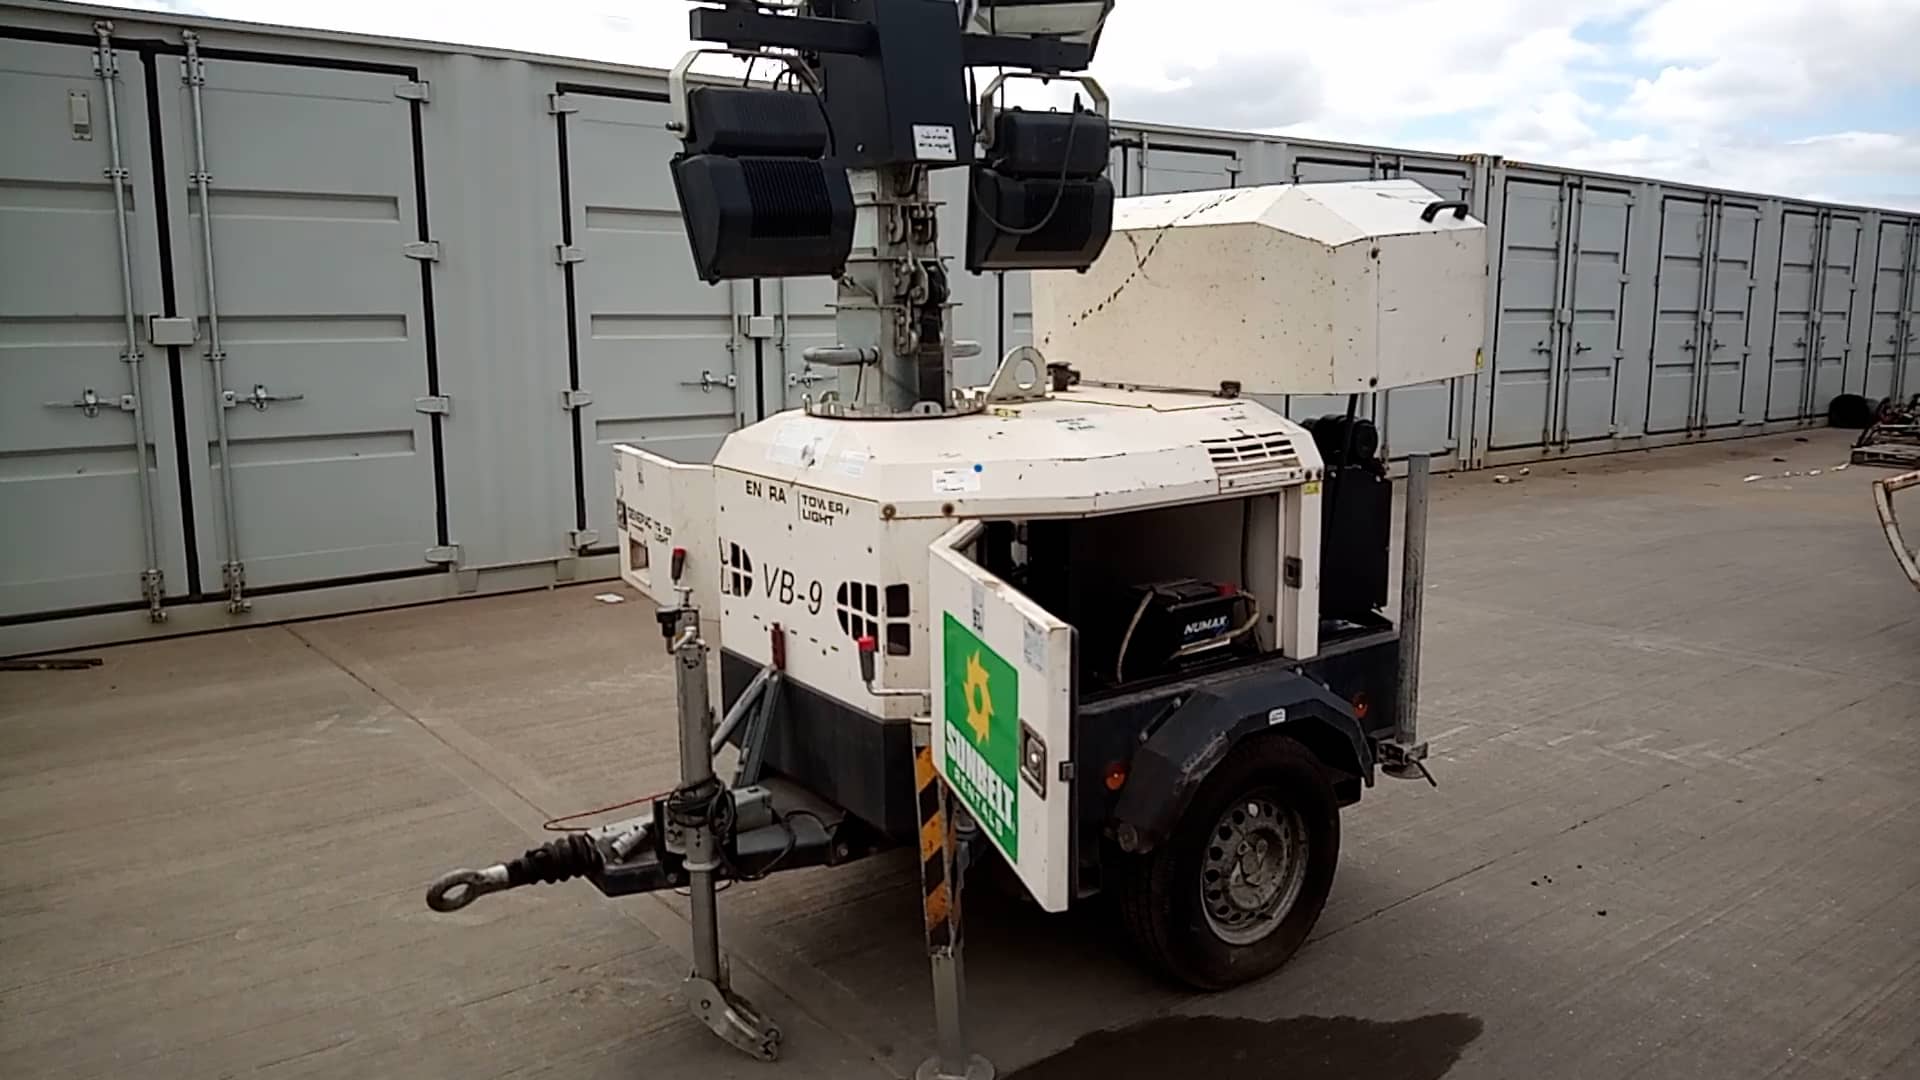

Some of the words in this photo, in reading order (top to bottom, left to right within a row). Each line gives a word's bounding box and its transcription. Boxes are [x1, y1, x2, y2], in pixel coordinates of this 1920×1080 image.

[802, 509, 834, 526] LIGHT
[763, 562, 822, 615] VB-9
[1183, 615, 1228, 635] NUMAX
[946, 719, 1015, 831] SUNBELT
